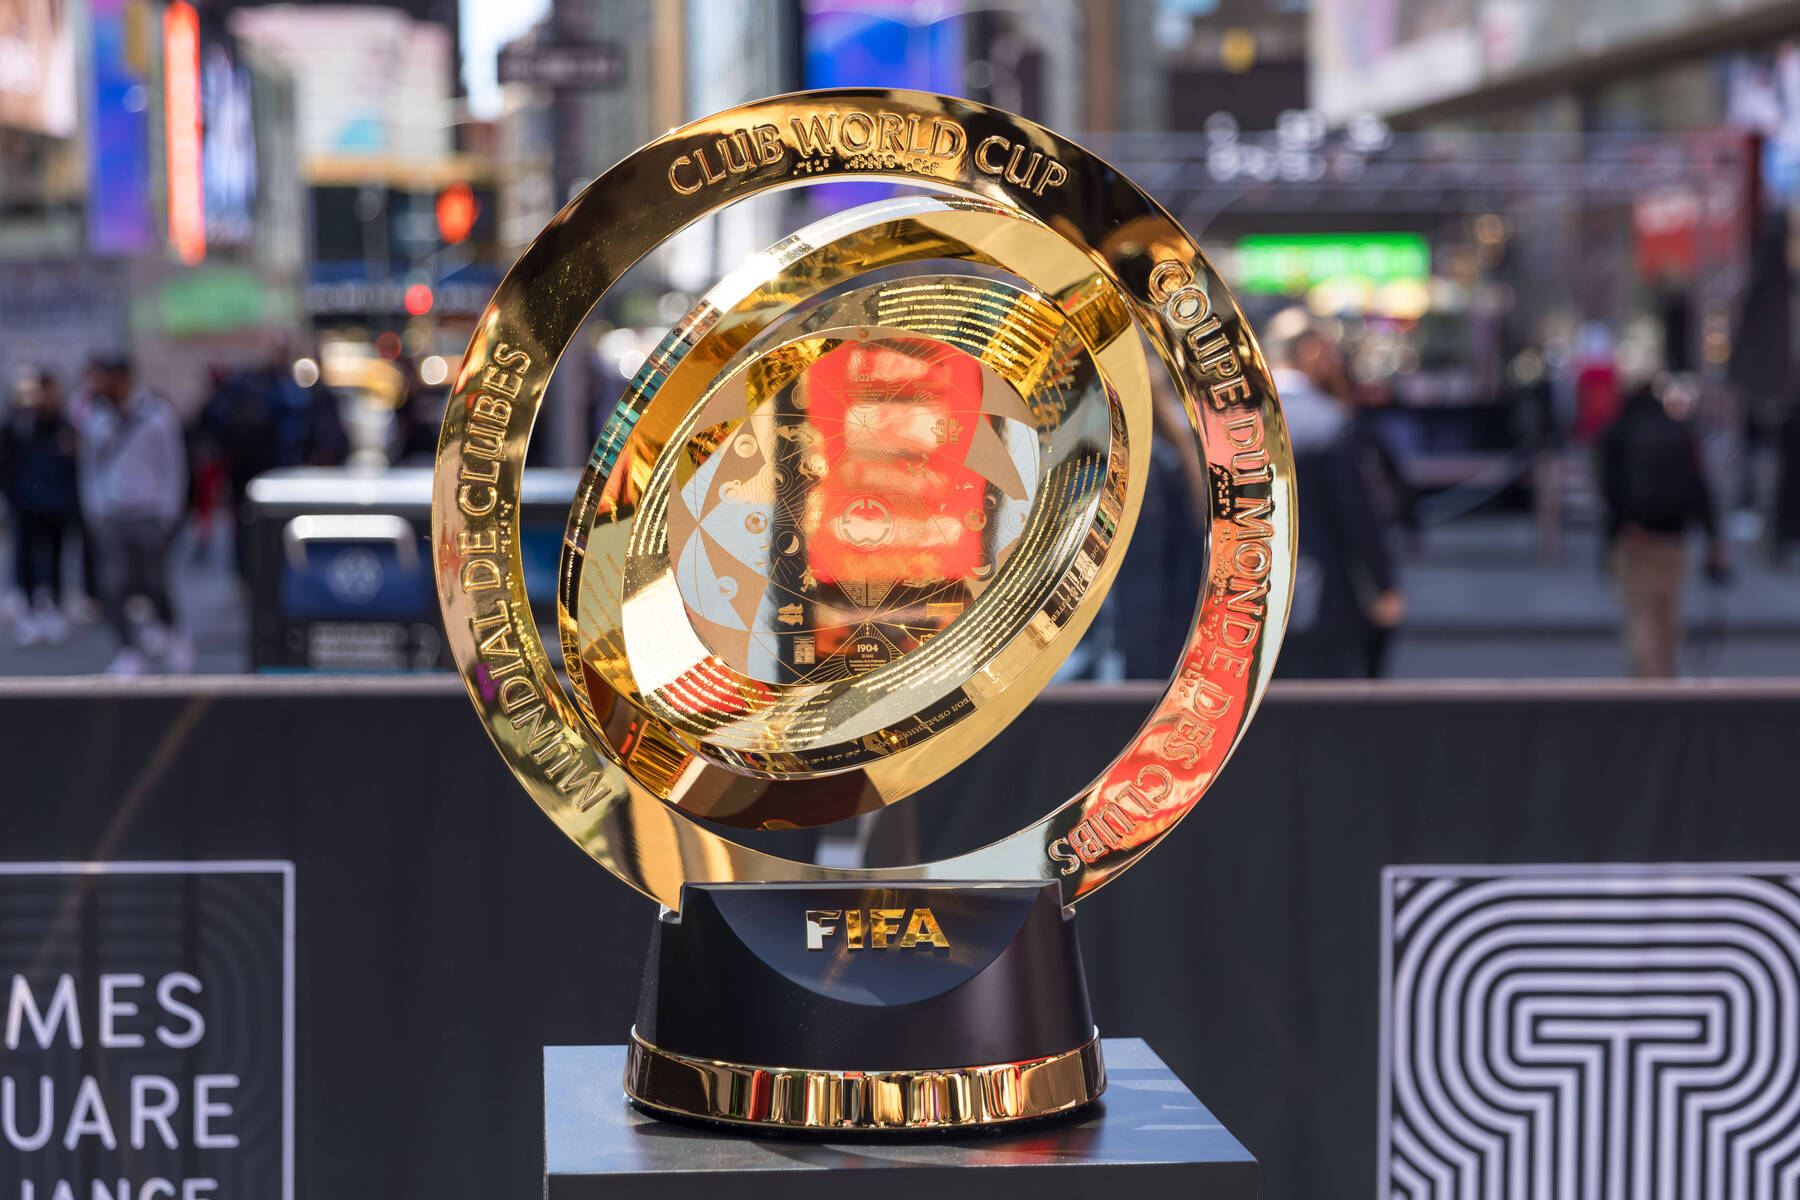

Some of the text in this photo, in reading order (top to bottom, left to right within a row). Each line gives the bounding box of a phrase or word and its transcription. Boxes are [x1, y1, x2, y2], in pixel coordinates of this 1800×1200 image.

[667, 112, 1069, 196] CLUB WORLD CUP
[459, 343, 613, 812] MUNDIAL DE CLUBES
[1048, 259, 1275, 876] COUPE DU MONDE DES CLUBS
[857, 643, 879, 653] 1904
[805, 908, 950, 949] FIFA
[5, 972, 205, 1049] MES
[2, 1074, 240, 1151] UARE
